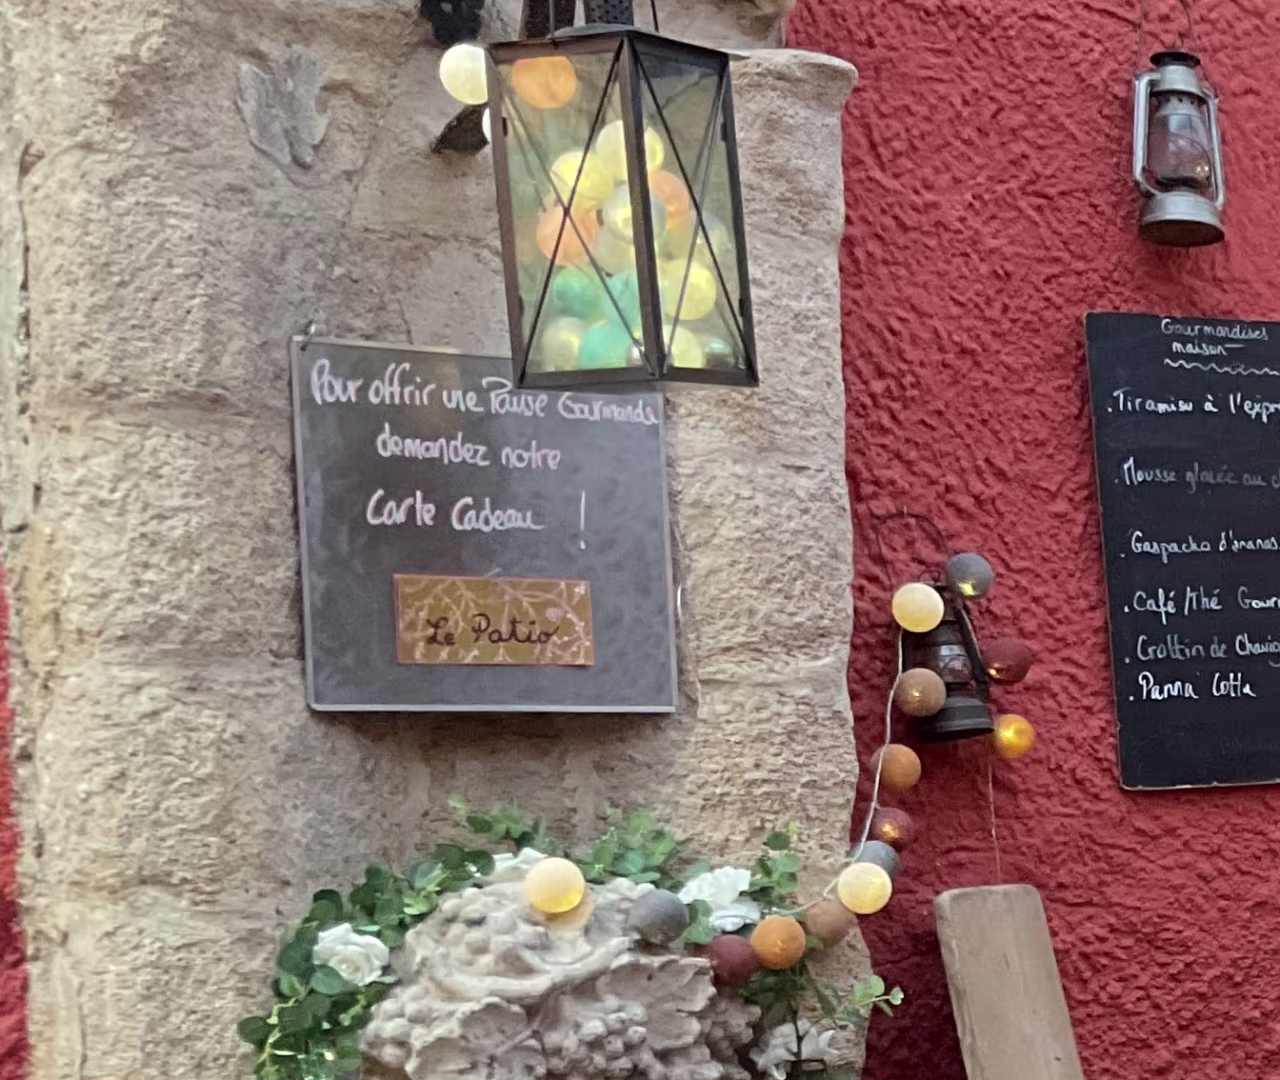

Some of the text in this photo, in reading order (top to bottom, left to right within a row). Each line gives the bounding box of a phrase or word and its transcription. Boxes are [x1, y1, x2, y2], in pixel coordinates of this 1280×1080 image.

[311, 359, 362, 404] Pour
[369, 363, 437, 407] offrir
[443, 389, 483, 412] une
[482, 376, 548, 418] Pause
[1205, 395, 1218, 412] à
[377, 423, 561, 470] demandez notre
[1124, 456, 1177, 485] Mousse
[367, 489, 435, 526] Carte
[451, 497, 545, 531] Cadeau
[471, 614, 561, 645] Patio
[1138, 671, 1198, 700] Panna
